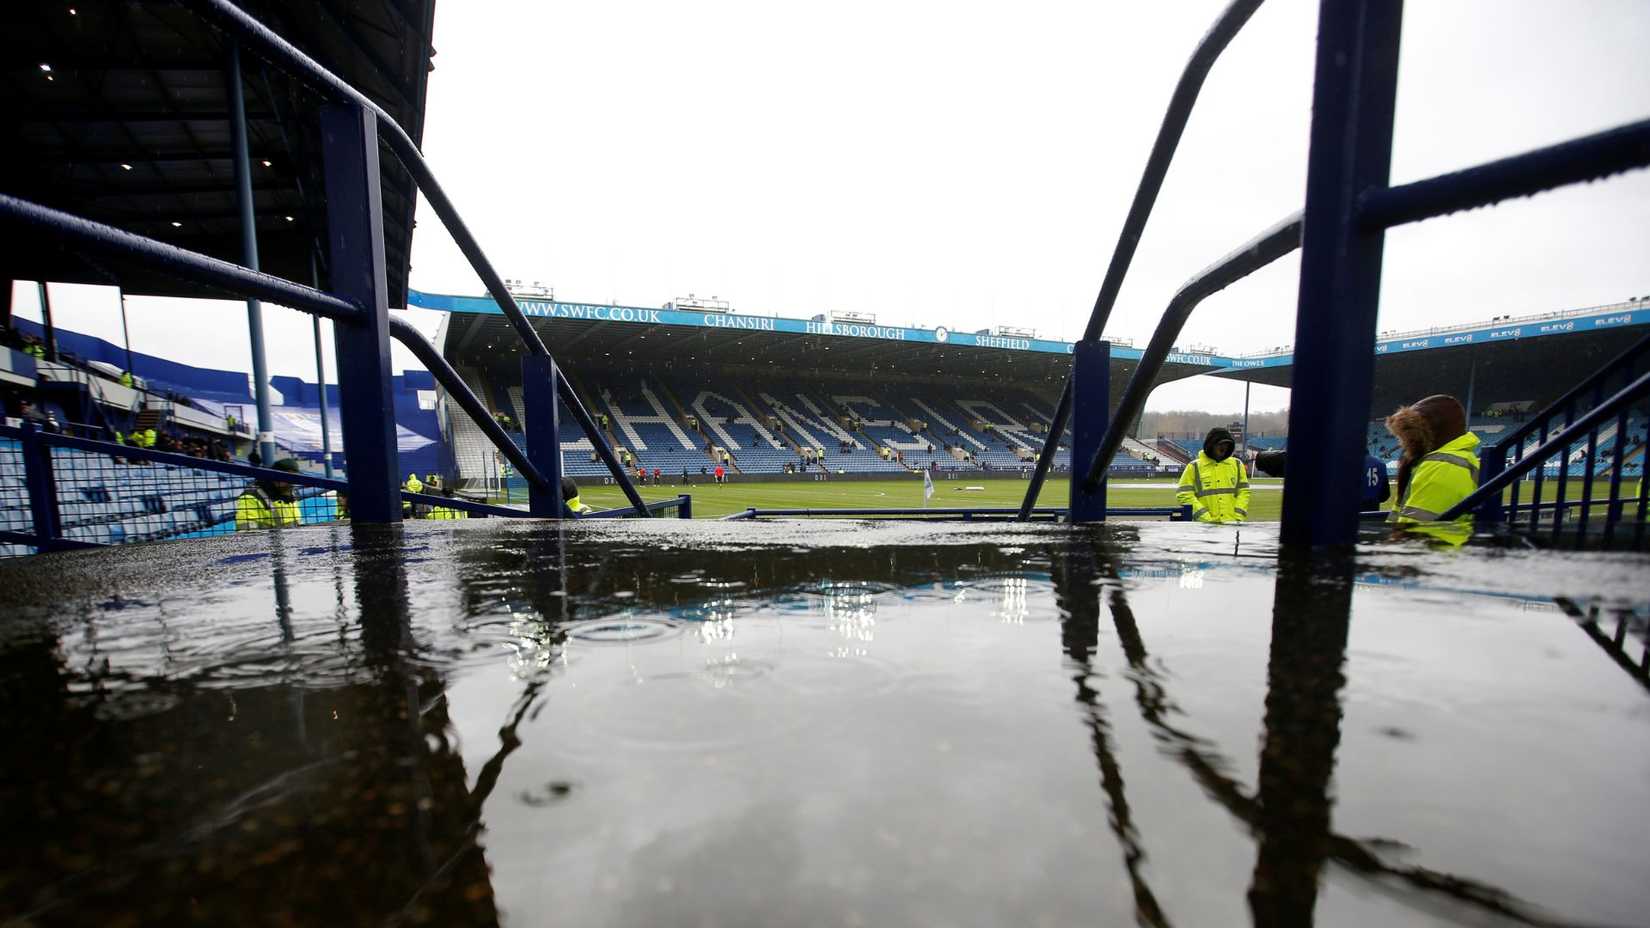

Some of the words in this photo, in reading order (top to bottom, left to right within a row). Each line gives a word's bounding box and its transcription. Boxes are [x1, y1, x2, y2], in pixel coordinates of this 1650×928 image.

[516, 301, 660, 323] WW.SWFC.CO.UK
[703, 314, 775, 331] CHANSIRI
[806, 321, 905, 341] HILLSBOROUGH
[1444, 334, 1473, 344] ELEV8
[1490, 328, 1521, 338] ELEV8
[975, 334, 1030, 351] SHEFFIELD
[1366, 467, 1379, 487] 15
